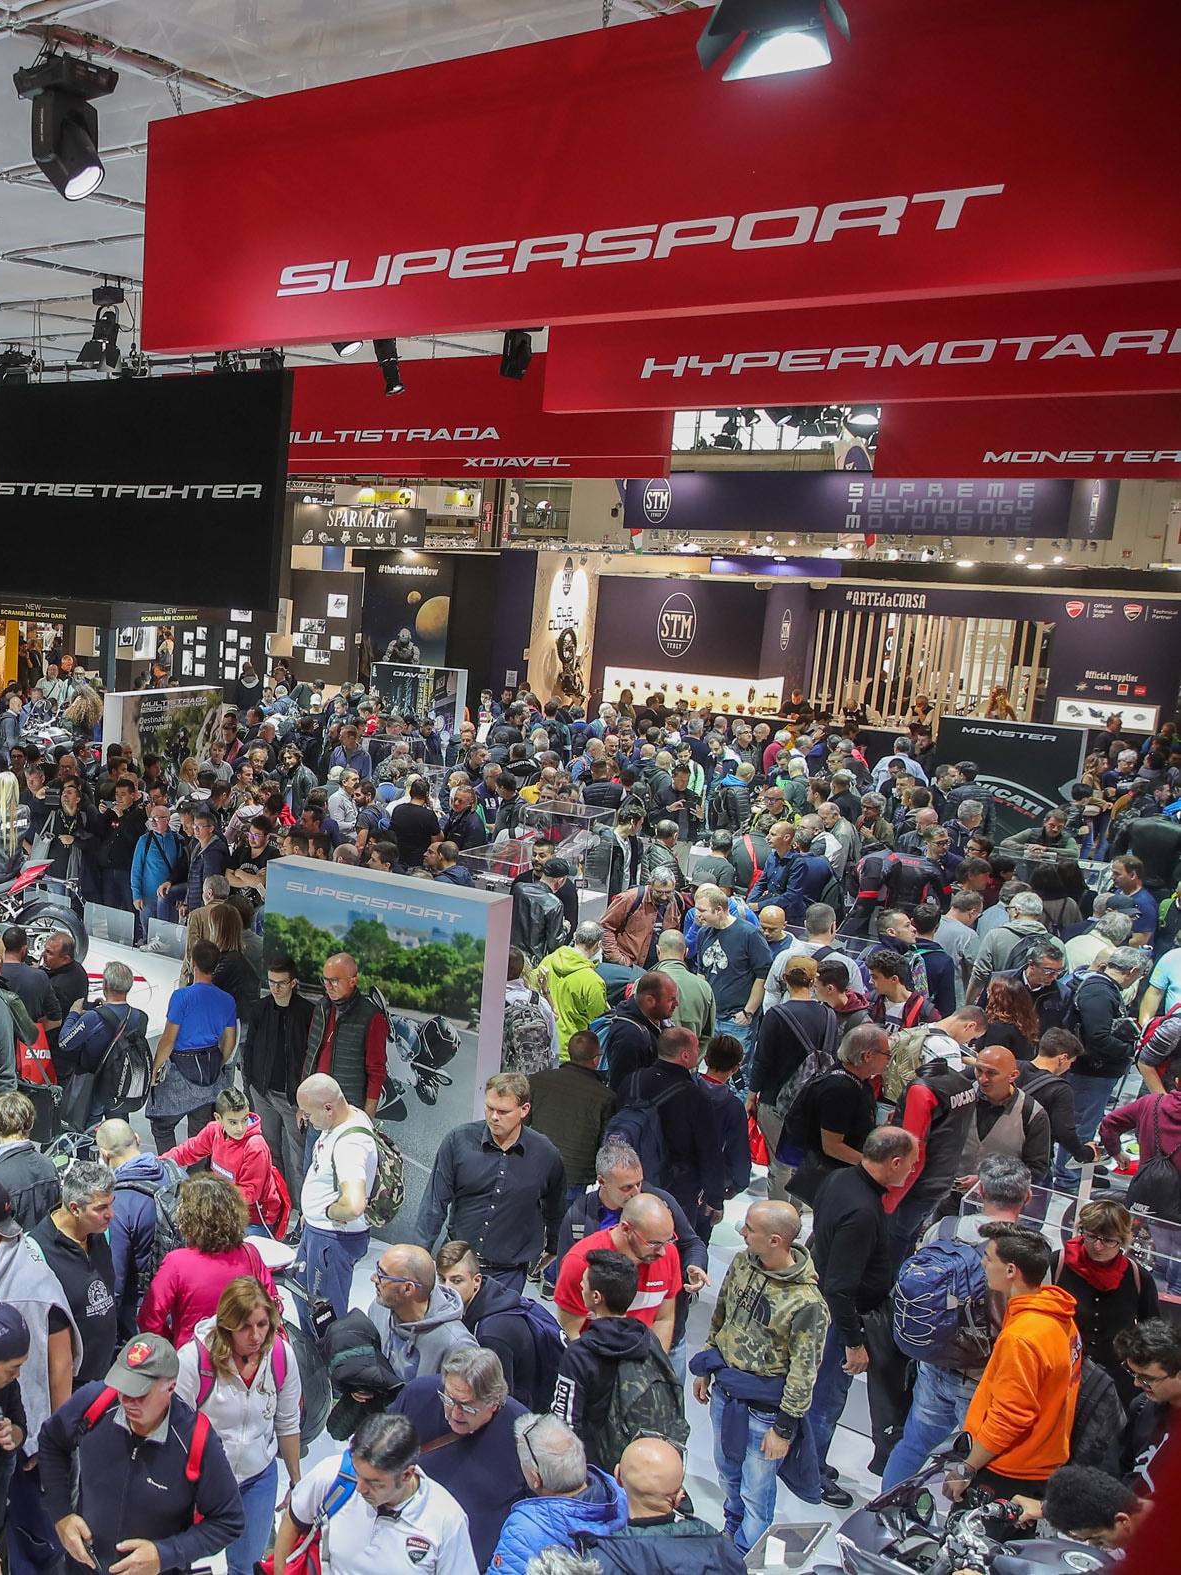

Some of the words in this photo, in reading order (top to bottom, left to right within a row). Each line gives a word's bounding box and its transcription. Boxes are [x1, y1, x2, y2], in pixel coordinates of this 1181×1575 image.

[276, 184, 1006, 297] SUPERSPORT
[640, 328, 1181, 379] HYPERMOTAR
[289, 426, 501, 443] ULTISTRADA
[462, 456, 571, 468] XDIAVEL
[847, 482, 1036, 498] SUPREME
[646, 491, 669, 510] STM
[845, 498, 1035, 516] TECHNOLOGY
[845, 590, 927, 609] #ARTEdaCORSA
[0, 608, 33, 618] SCRAMBLER
[50, 612, 67, 620] DARK
[25, 603, 42, 611] NEW
[163, 607, 177, 615] NEW
[556, 606, 573, 618] CLG
[140, 614, 171, 623] SCRAMBLER
[172, 614, 184, 622] ICON
[185, 614, 198, 622] DARK
[548, 619, 579, 631] CLUTCH
[661, 613, 694, 640] STM
[392, 670, 435, 681] DIAVEL
[1084, 670, 1109, 681] Official
[1110, 673, 1139, 683] supplier
[141, 696, 208, 708] MULTISTRADA
[140, 715, 173, 725] Destination
[961, 726, 1058, 742] MONSTER
[976, 781, 1045, 816] UCATI
[285, 880, 464, 924] SUPERSPORT
[316, 1310, 332, 1325] DUCATI
[407, 1538, 429, 1549] DUCATI
